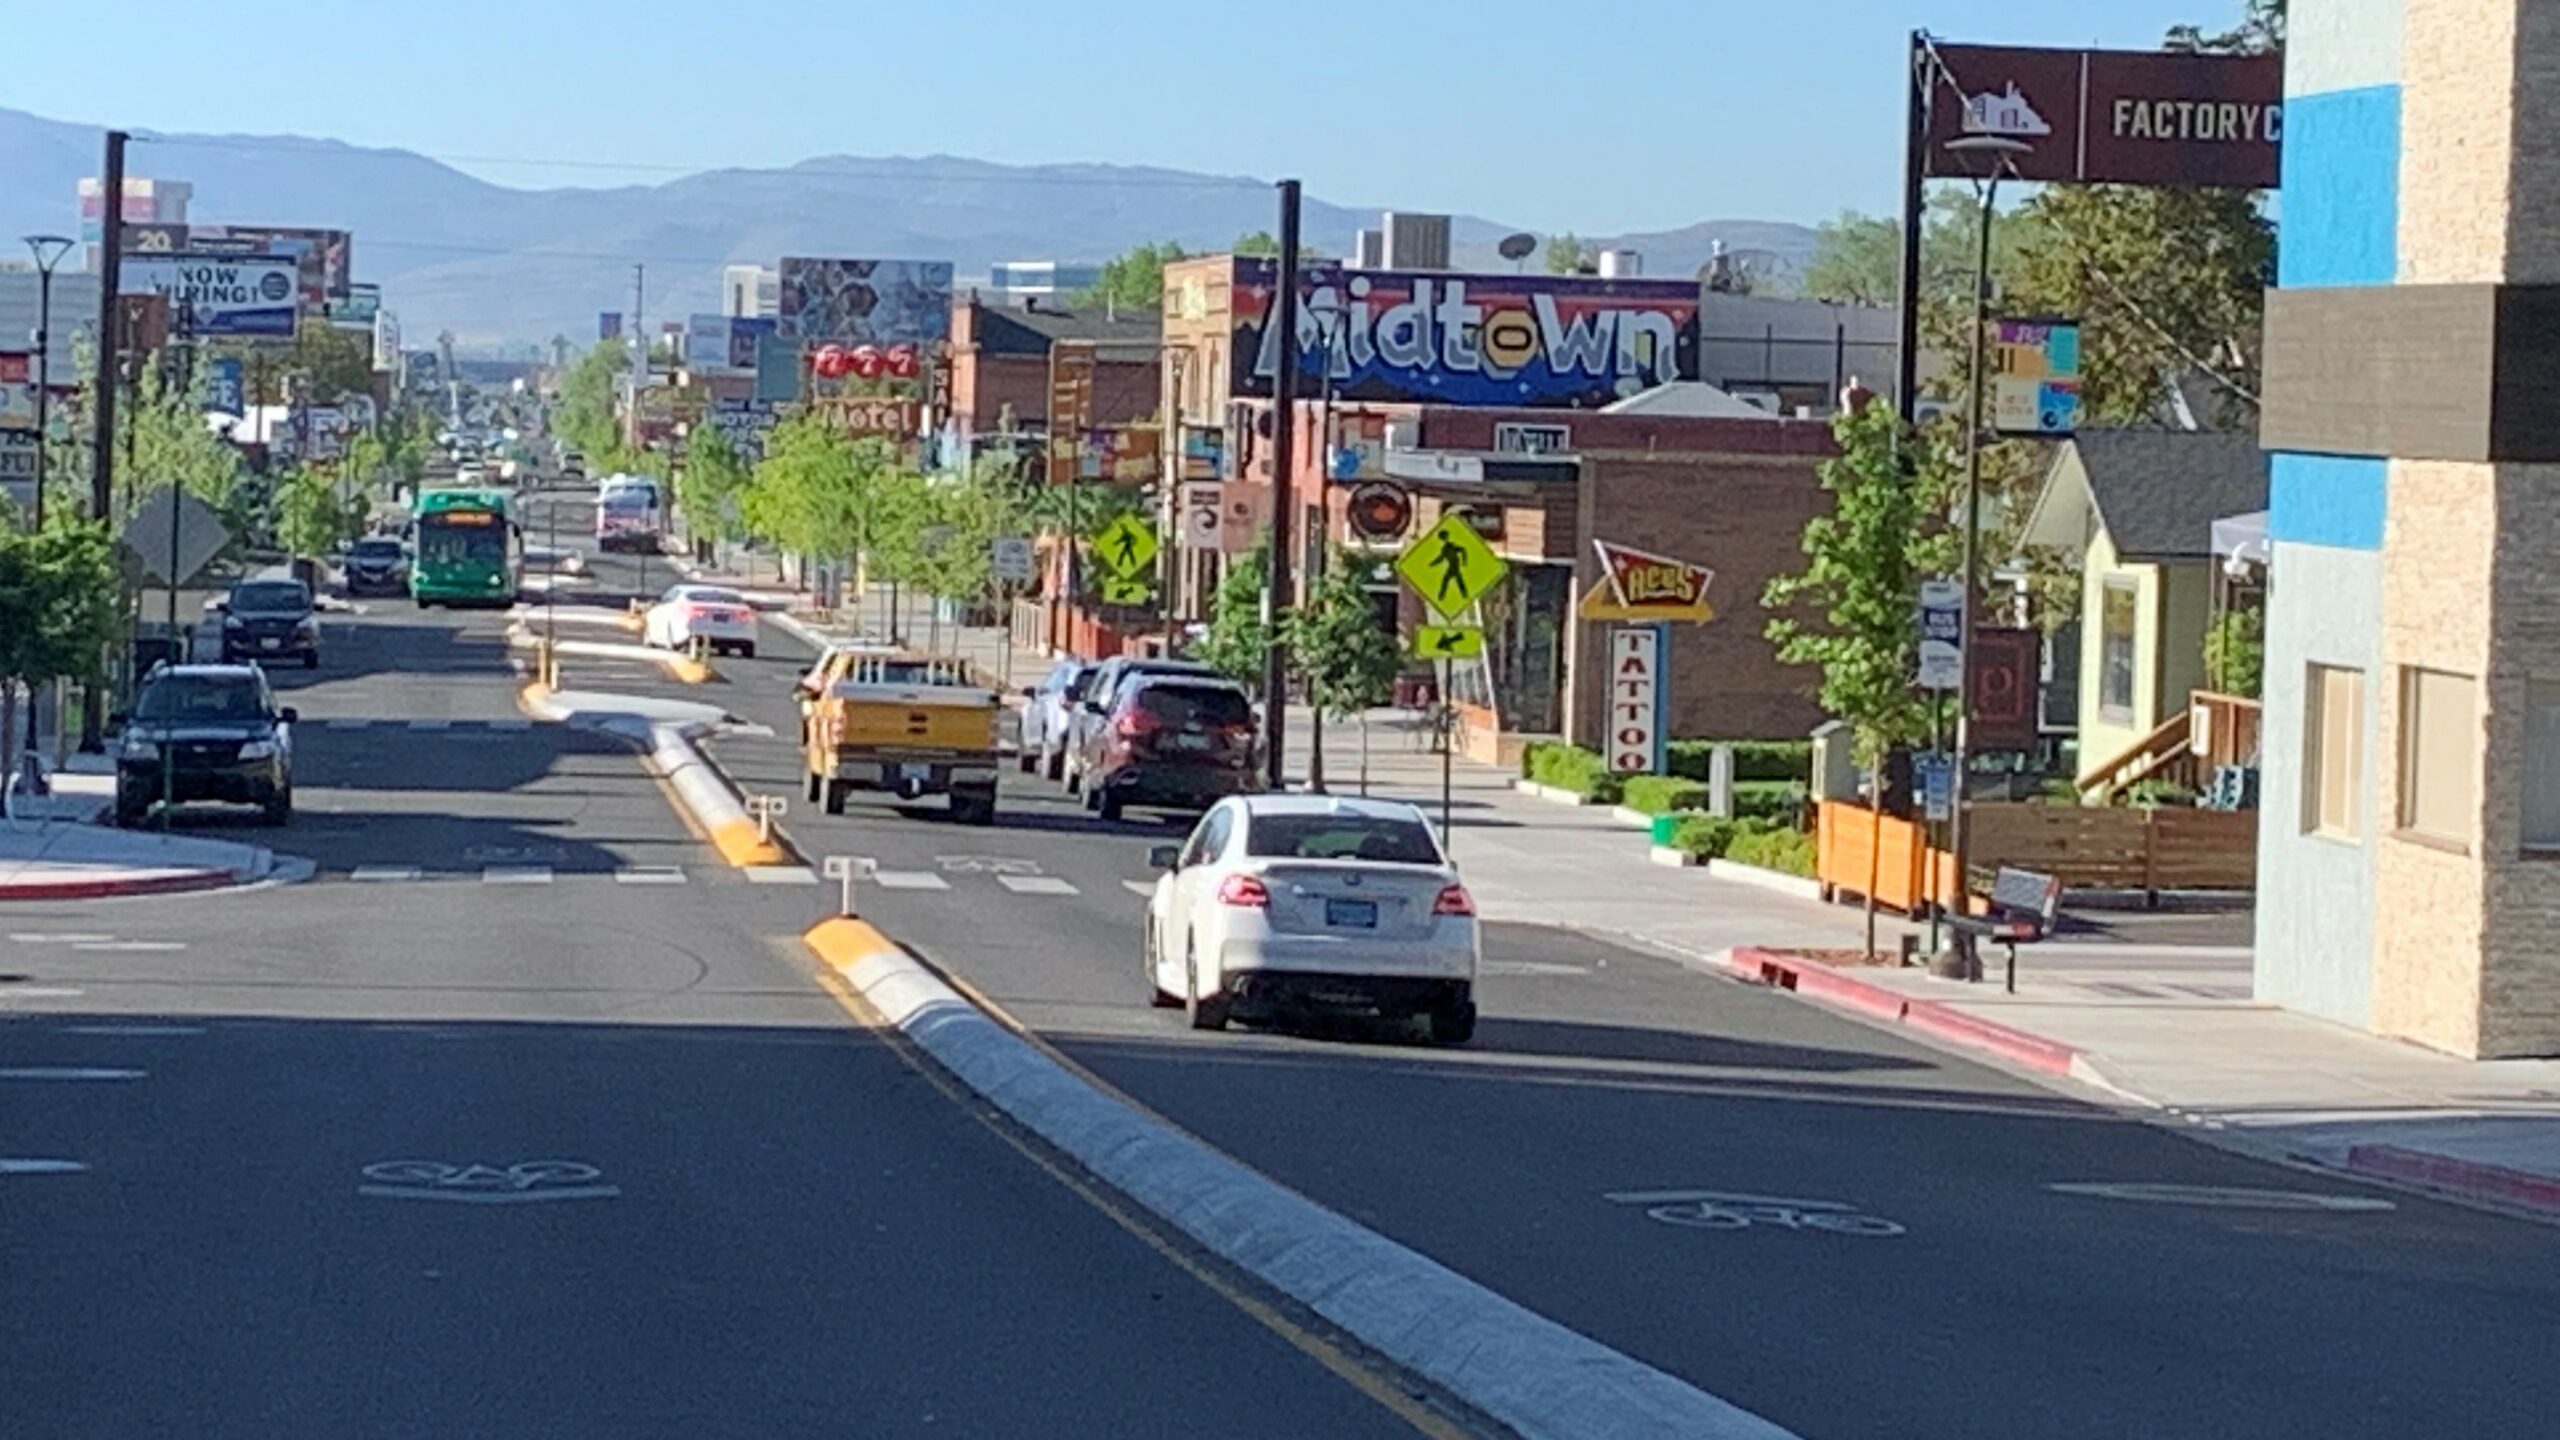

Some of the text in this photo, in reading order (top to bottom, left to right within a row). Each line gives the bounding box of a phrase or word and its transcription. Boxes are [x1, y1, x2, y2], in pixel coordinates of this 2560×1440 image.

[136, 229, 171, 252] 20
[178, 266, 238, 285] NOW
[822, 402, 912, 430] Motel
[1616, 633, 1651, 770] TATTOO
